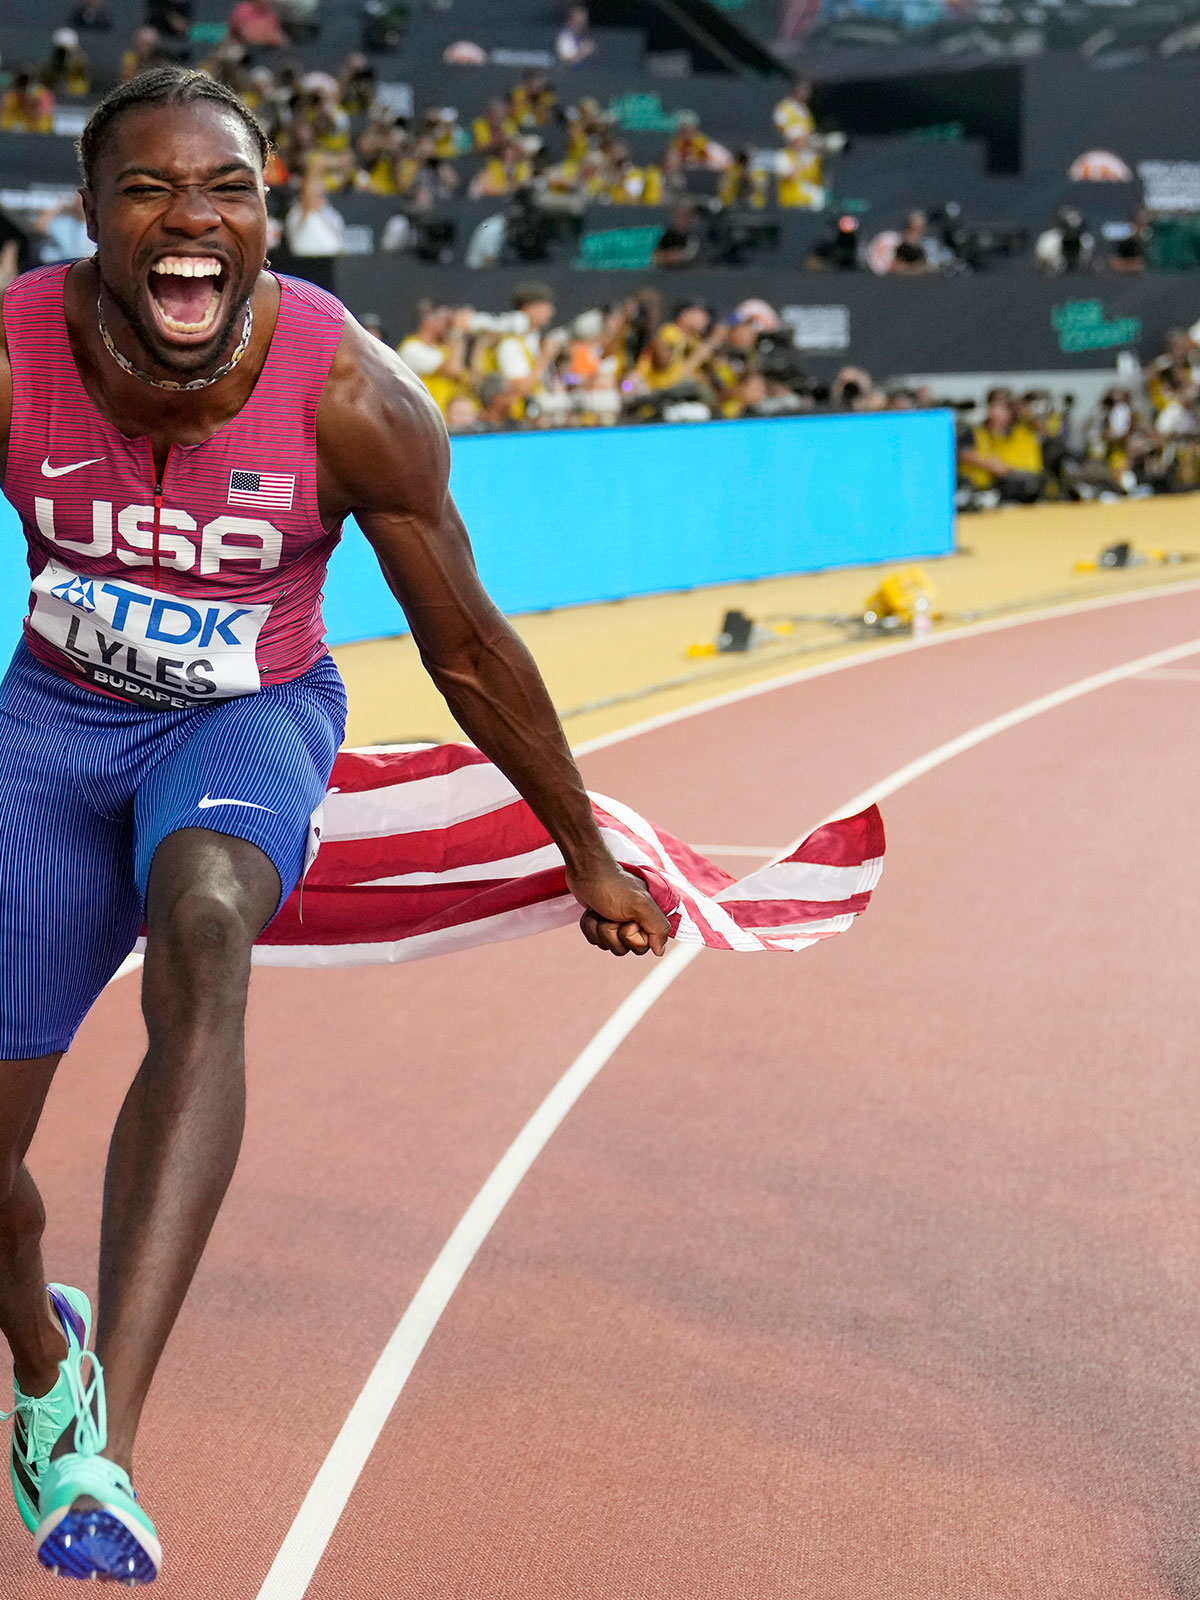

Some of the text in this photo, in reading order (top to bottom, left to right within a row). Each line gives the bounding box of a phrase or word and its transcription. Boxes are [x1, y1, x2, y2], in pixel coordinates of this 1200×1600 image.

[35, 496, 283, 575] USA
[101, 583, 254, 648] TDK
[65, 615, 217, 695] LYLES
[93, 670, 213, 709] BUDAPES
